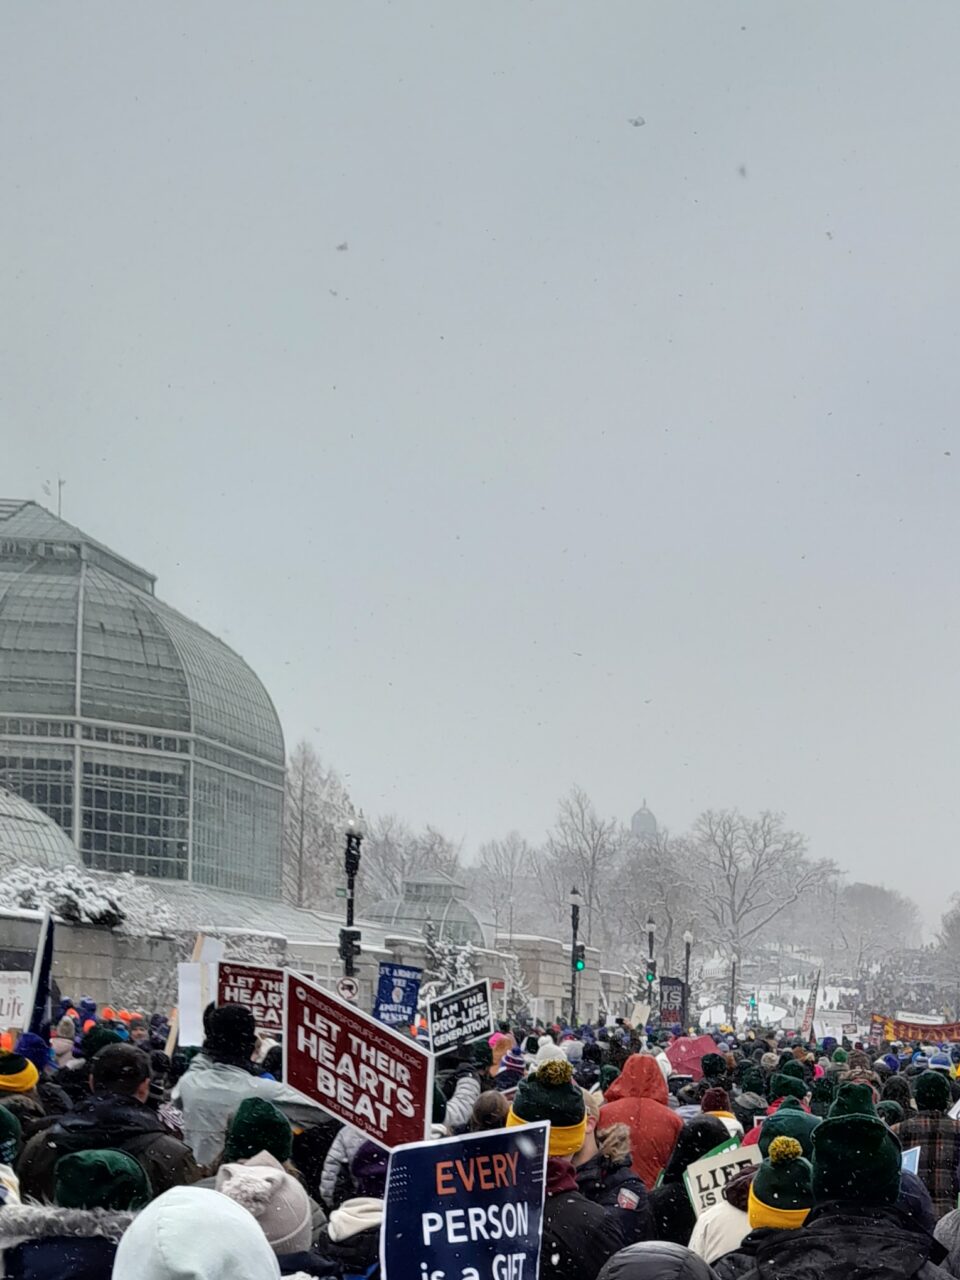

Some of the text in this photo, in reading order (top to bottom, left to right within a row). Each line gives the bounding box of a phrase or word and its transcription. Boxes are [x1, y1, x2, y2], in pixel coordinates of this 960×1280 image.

[224, 986, 283, 1009] HEAR
[229, 974, 284, 992] LET THE
[662, 991, 682, 1004] IS
[247, 1004, 283, 1024] EA
[432, 1003, 489, 1036] PRO-LIFE
[433, 1011, 438, 1021] I
[441, 1003, 459, 1018] AM
[462, 992, 485, 1009] THE
[434, 1017, 490, 1046] GENERATION
[303, 1006, 411, 1087] LET THEIR
[297, 1025, 416, 1118] HEARTS
[317, 1065, 394, 1132] BEAT
[435, 1151, 520, 1196] EVERY
[700, 1192, 717, 1209] IS
[422, 1202, 529, 1246] PERSON
